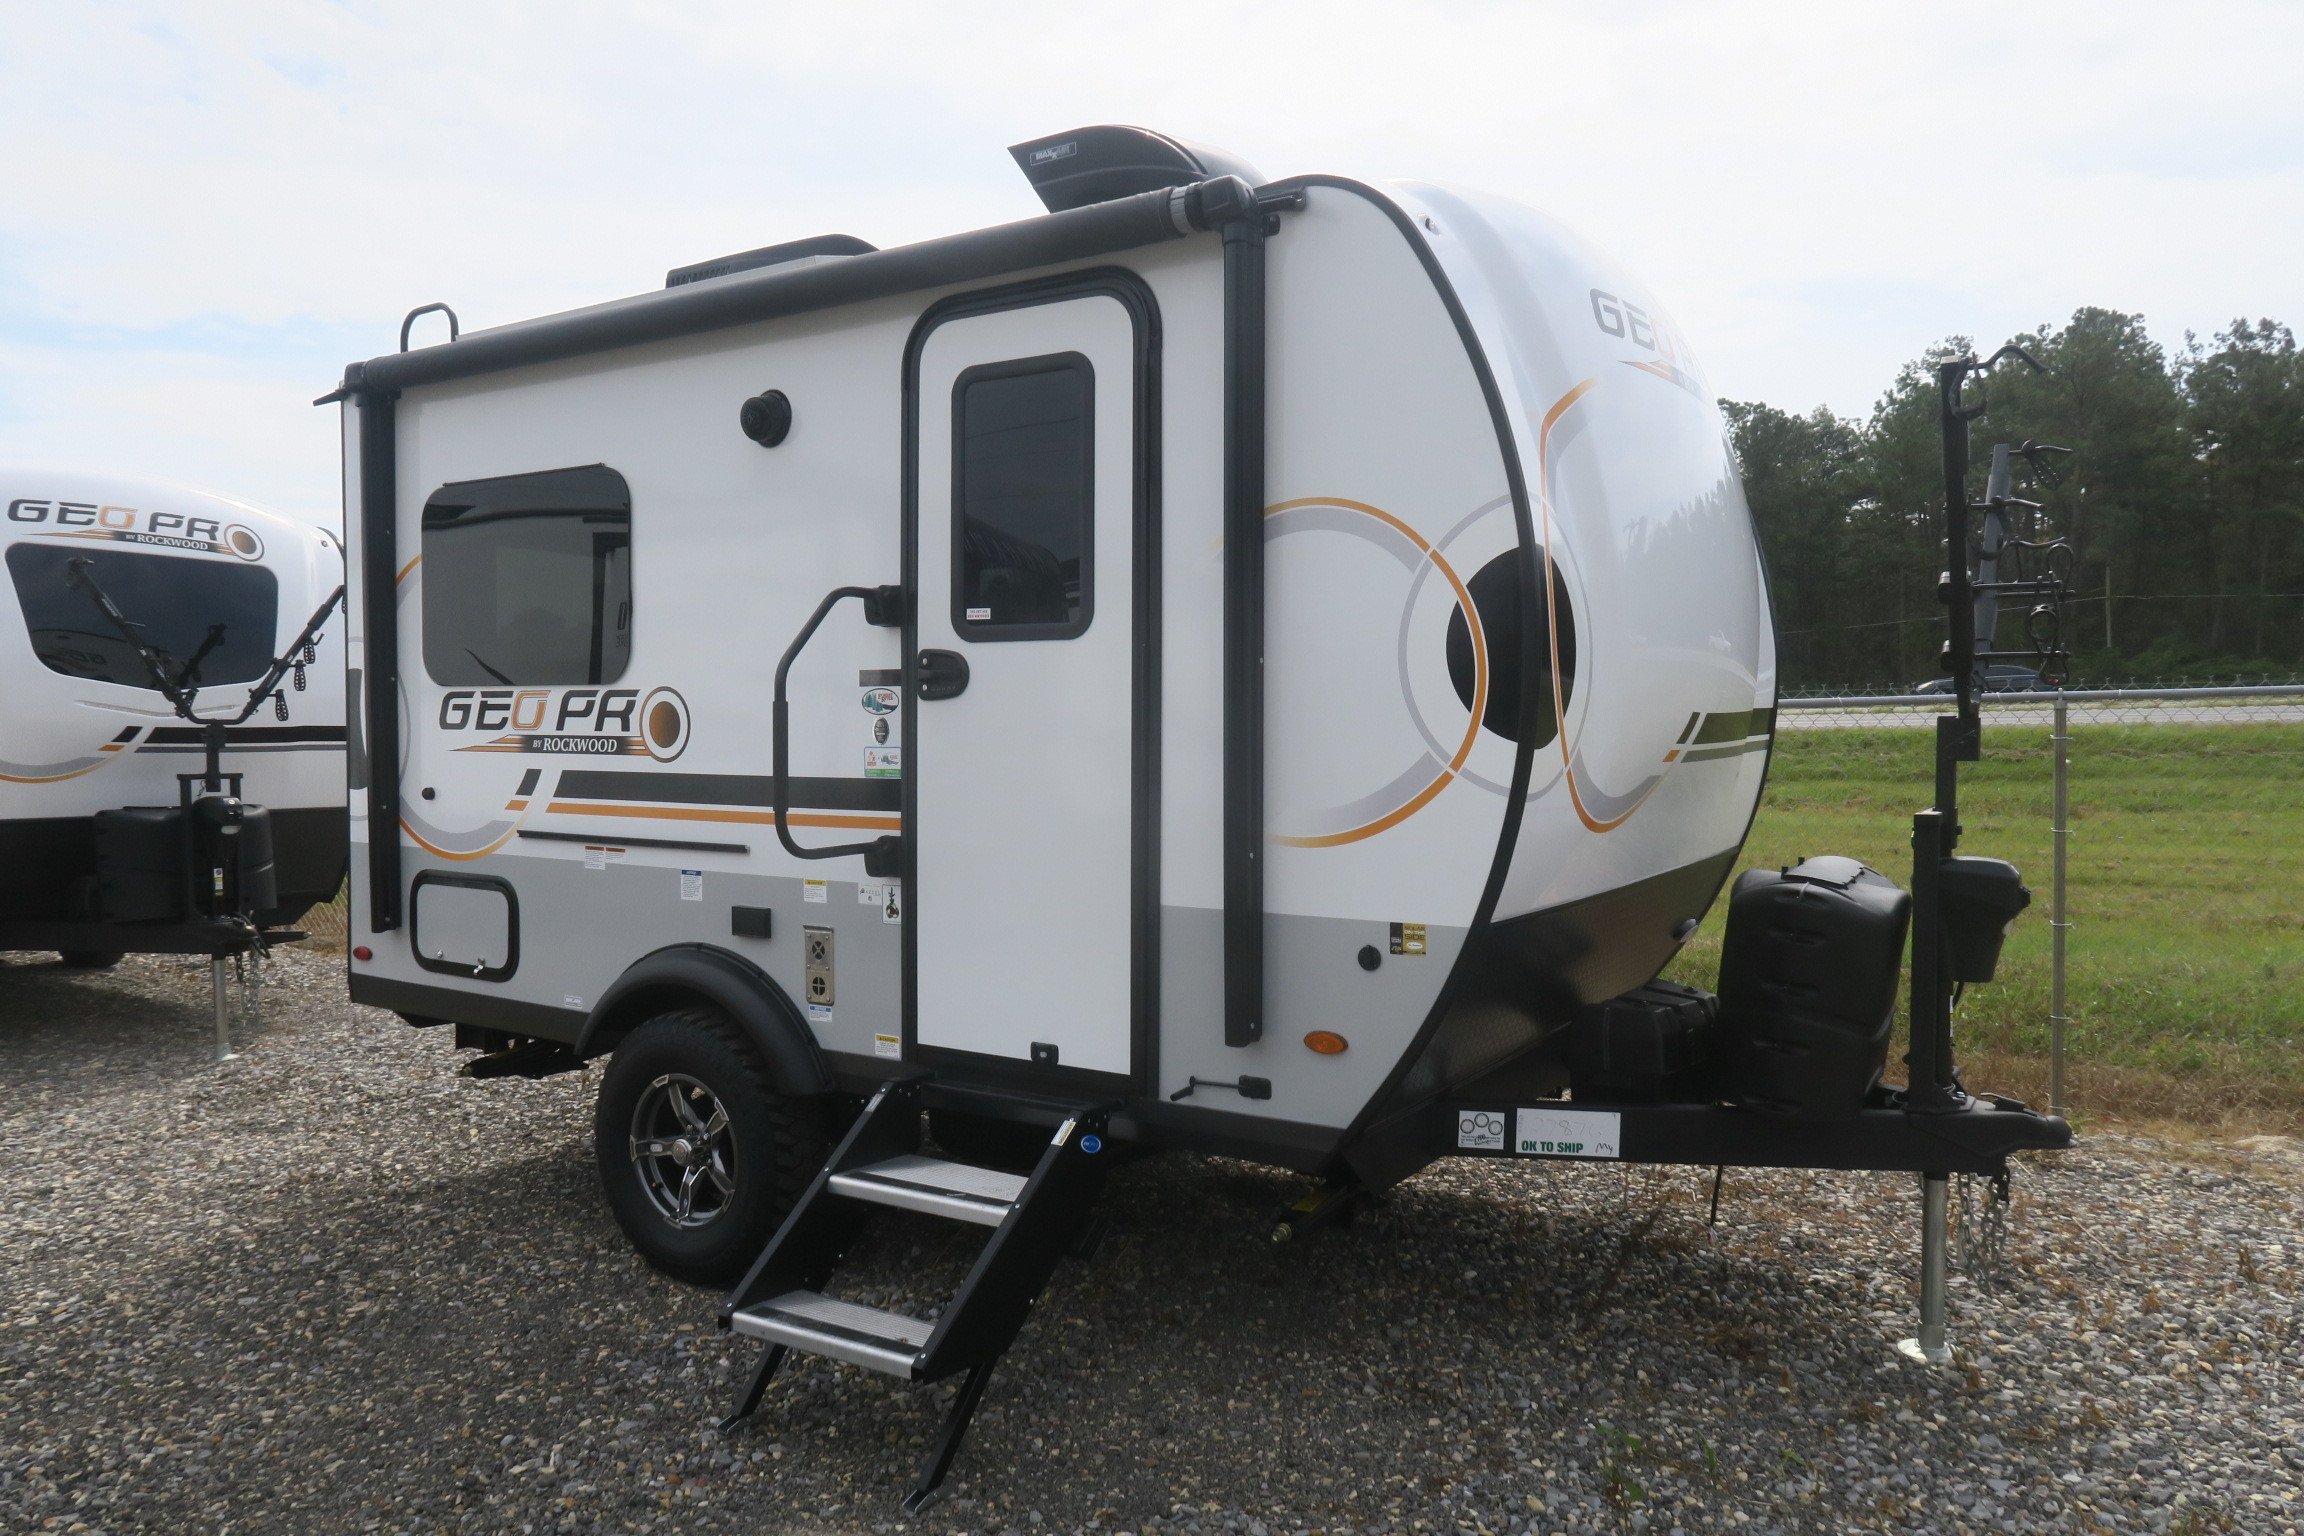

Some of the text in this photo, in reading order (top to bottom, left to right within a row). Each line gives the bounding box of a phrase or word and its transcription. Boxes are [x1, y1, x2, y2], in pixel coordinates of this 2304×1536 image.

[7, 498, 138, 530] GEO
[137, 534, 209, 552] ROCKWOOD
[439, 690, 551, 731] GEO
[532, 738, 618, 754] BY ROCKWOOD
[1521, 1140, 1584, 1153] OK TO SHIP
